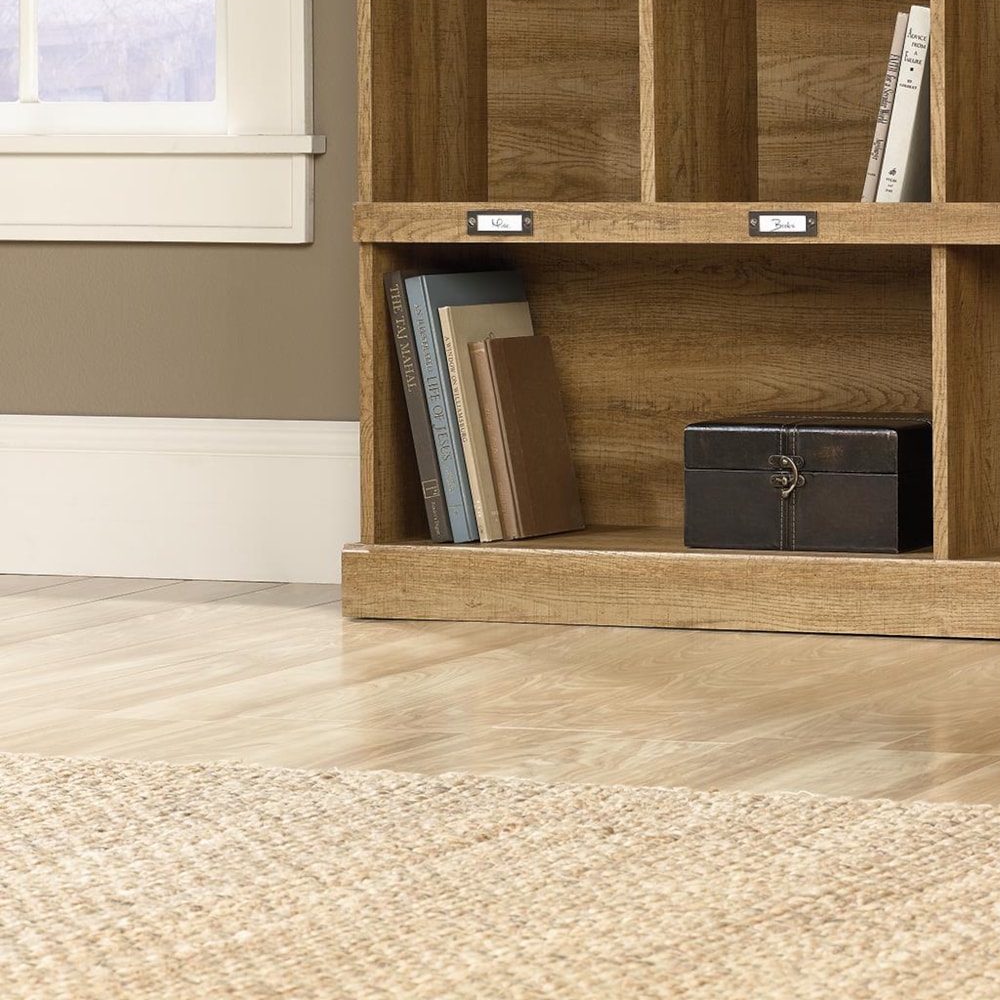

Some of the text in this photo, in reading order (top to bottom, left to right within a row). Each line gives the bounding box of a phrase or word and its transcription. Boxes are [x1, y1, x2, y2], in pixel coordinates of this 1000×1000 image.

[907, 28, 927, 41] ADVICE
[389, 282, 418, 393] THE TAJ MAHAL
[425, 374, 439, 402] LIFE
[445, 342, 455, 373] WINDOW
[453, 386, 468, 443] WILLIAMSBURG
[431, 403, 444, 423] OF
[432, 421, 452, 462] JESUS
